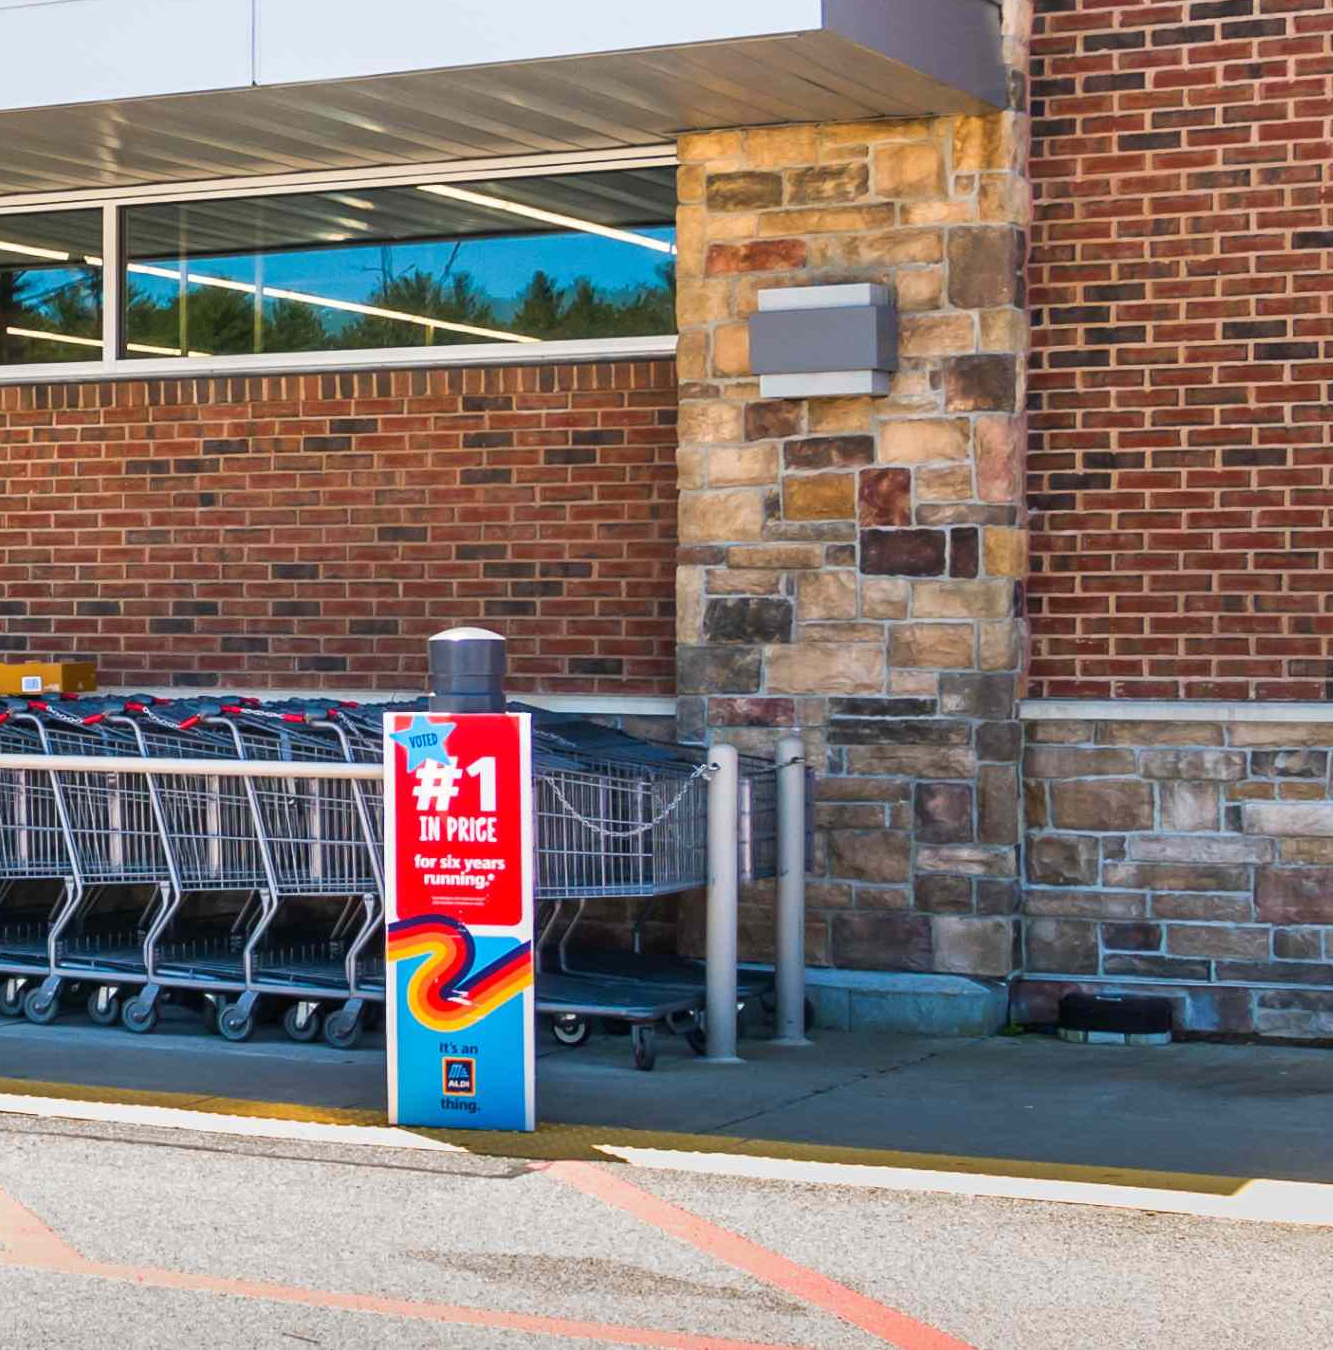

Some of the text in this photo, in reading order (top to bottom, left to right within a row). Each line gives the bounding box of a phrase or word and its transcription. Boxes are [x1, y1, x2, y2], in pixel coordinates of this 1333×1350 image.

[409, 732, 438, 749] VOTED
[412, 756, 497, 812] #1
[419, 815, 498, 843] IN PRICE
[414, 853, 506, 873] for six years
[460, 1045, 479, 1054] an
[447, 1080, 470, 1088] ALDI
[440, 1097, 481, 1114] thing.
